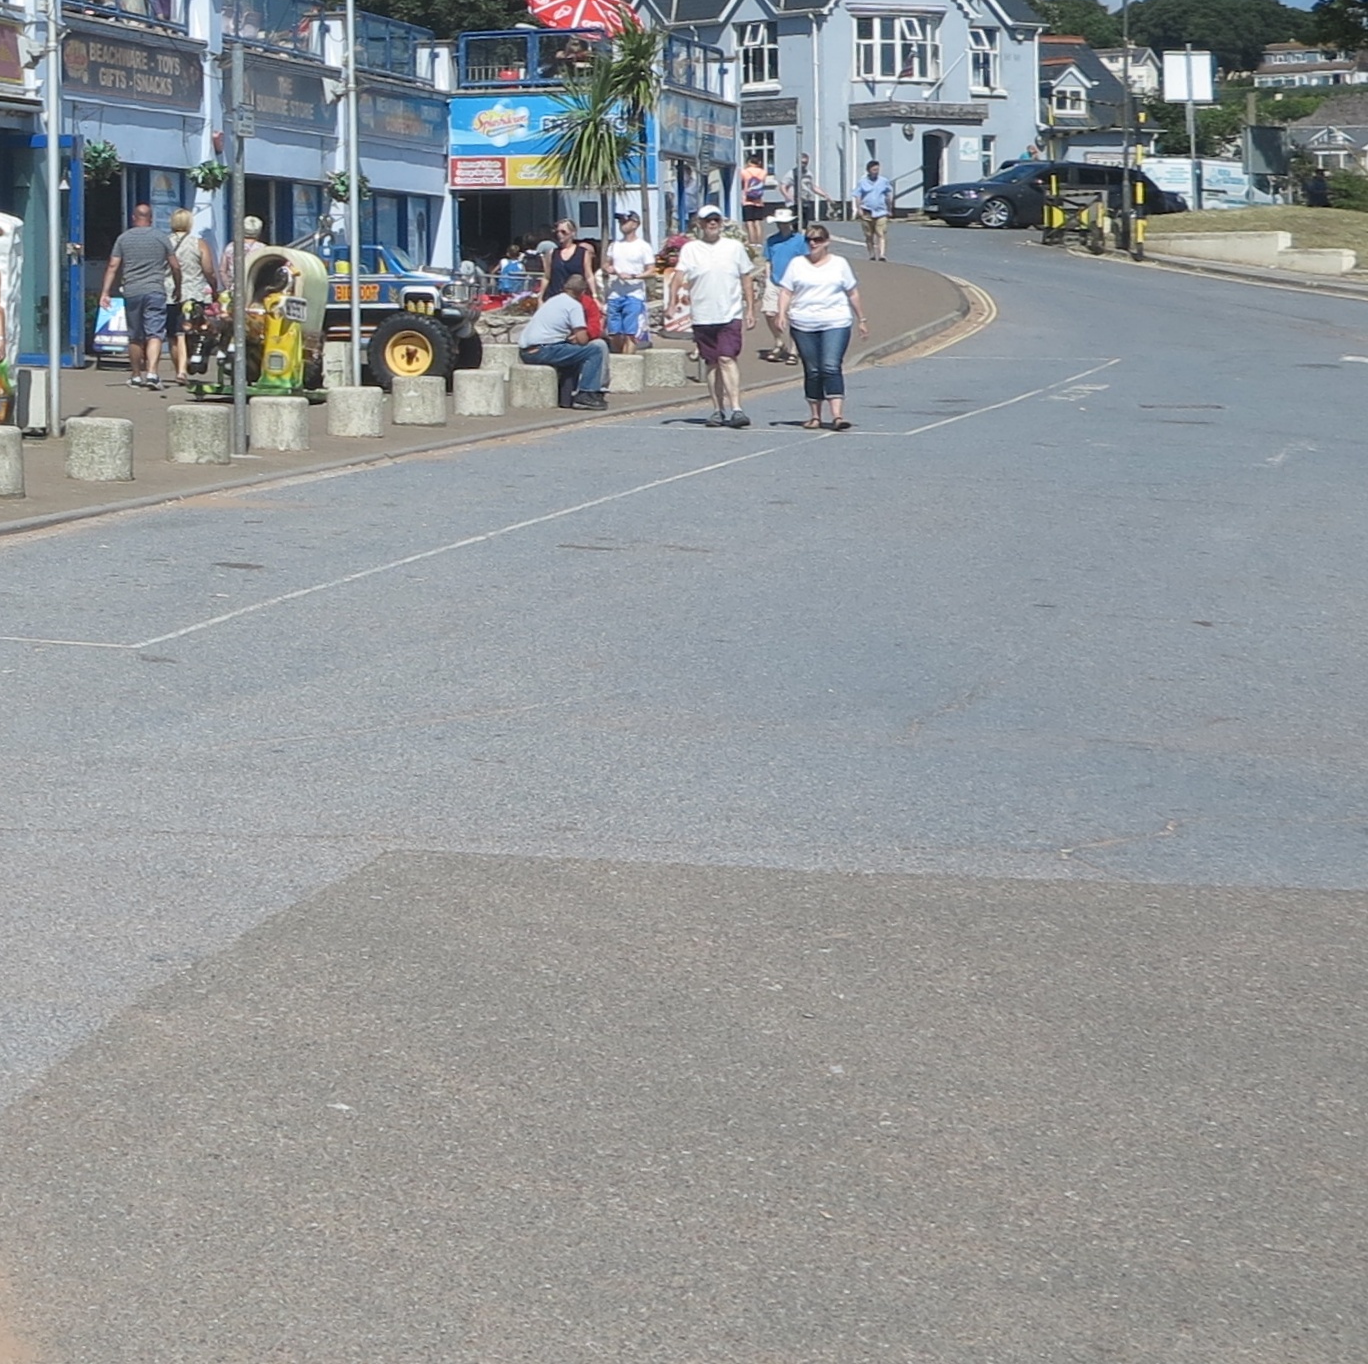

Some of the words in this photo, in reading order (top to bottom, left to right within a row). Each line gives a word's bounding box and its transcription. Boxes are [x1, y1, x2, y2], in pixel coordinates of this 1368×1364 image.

[89, 42, 148, 70] BEACHWARE
[156, 54, 180, 75] TOYS
[99, 67, 127, 88] GIFTS
[135, 74, 173, 95] SNACKS
